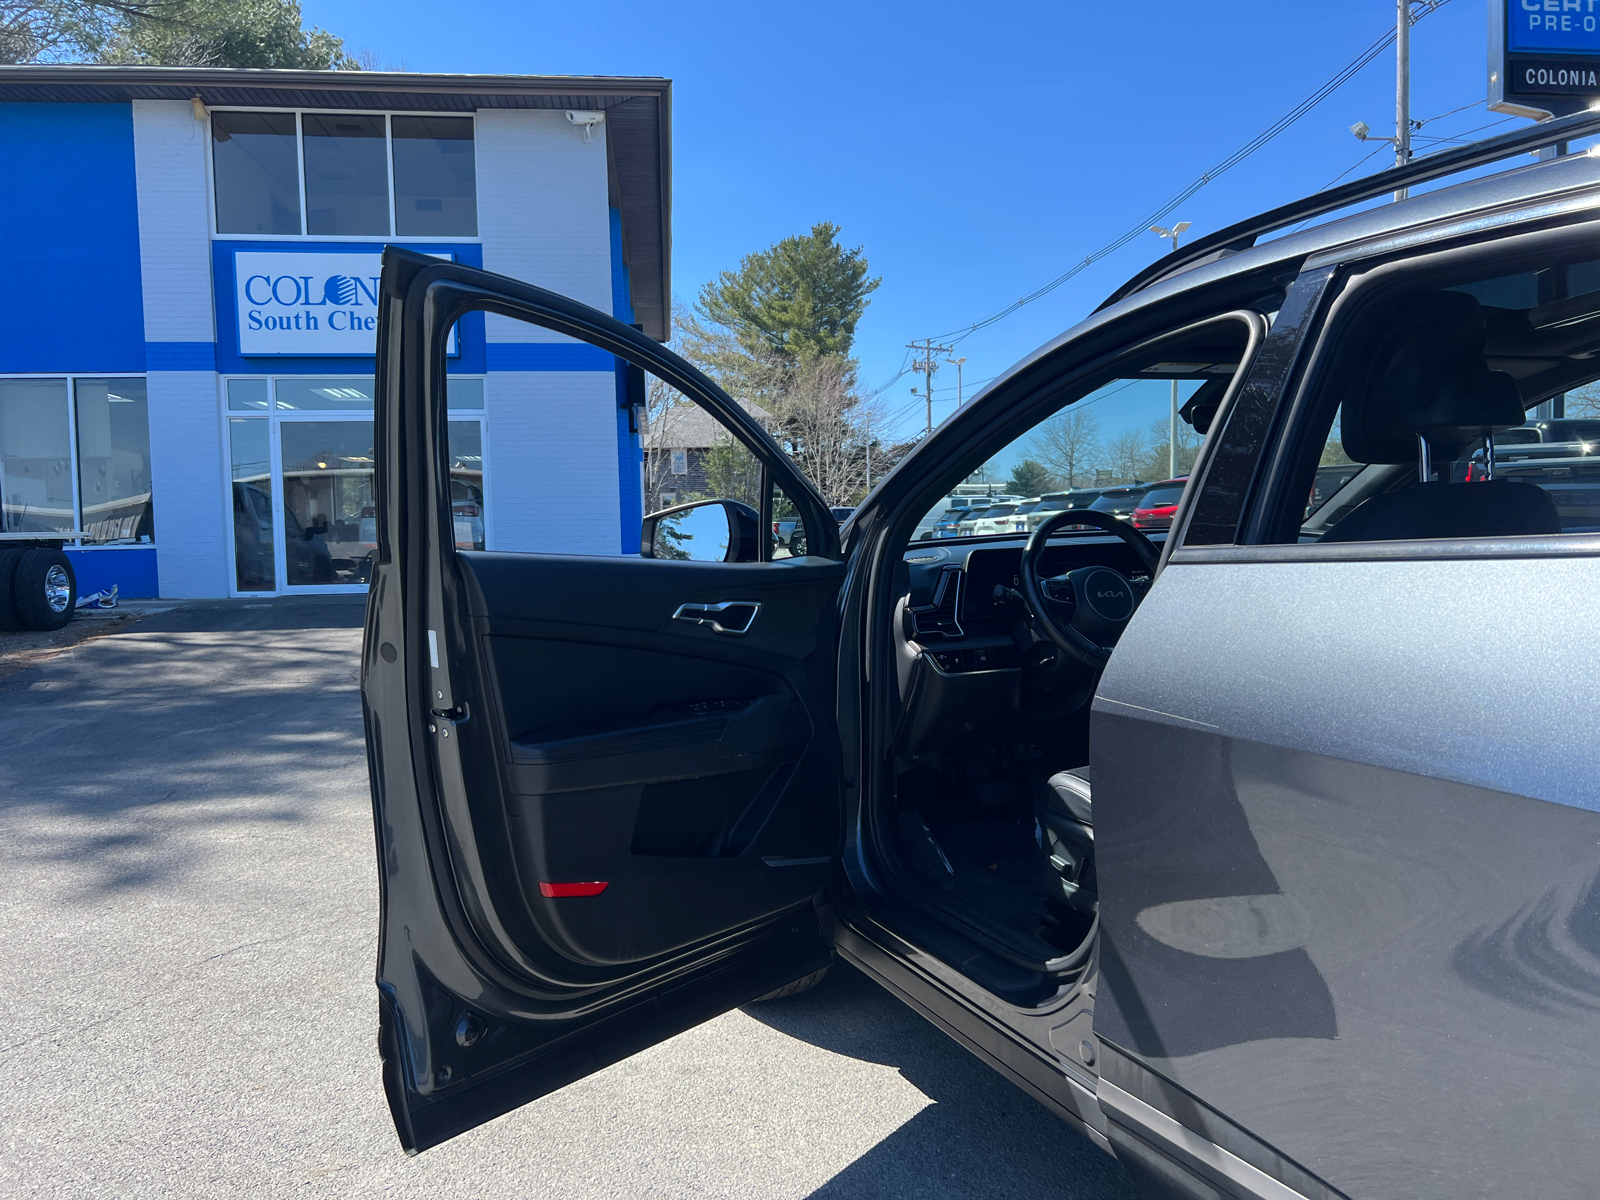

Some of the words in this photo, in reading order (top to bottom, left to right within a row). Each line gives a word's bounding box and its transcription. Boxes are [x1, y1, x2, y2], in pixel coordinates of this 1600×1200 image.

[1529, 14, 1600, 32] PRE-O
[1525, 68, 1600, 87] COLONIA
[245, 274, 381, 307] COLON
[248, 310, 320, 331] South
[328, 310, 379, 331] Che
